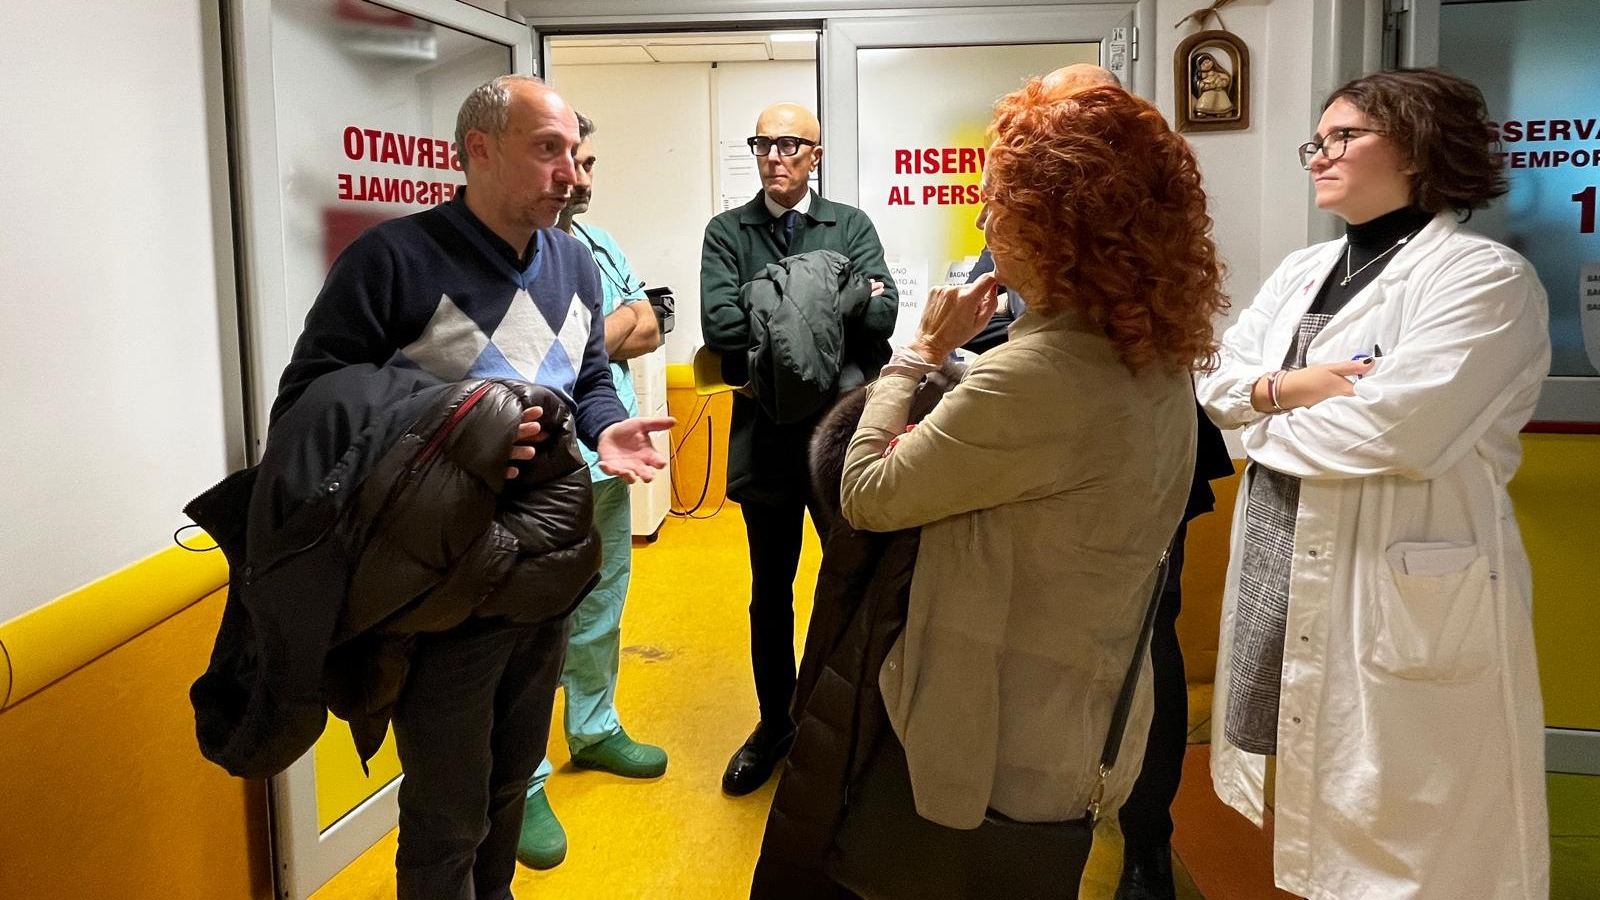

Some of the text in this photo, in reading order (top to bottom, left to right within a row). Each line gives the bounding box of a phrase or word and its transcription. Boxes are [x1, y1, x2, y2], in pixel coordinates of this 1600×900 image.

[1486, 119, 1600, 143] SSERV
[888, 185, 984, 205] AL PERS
